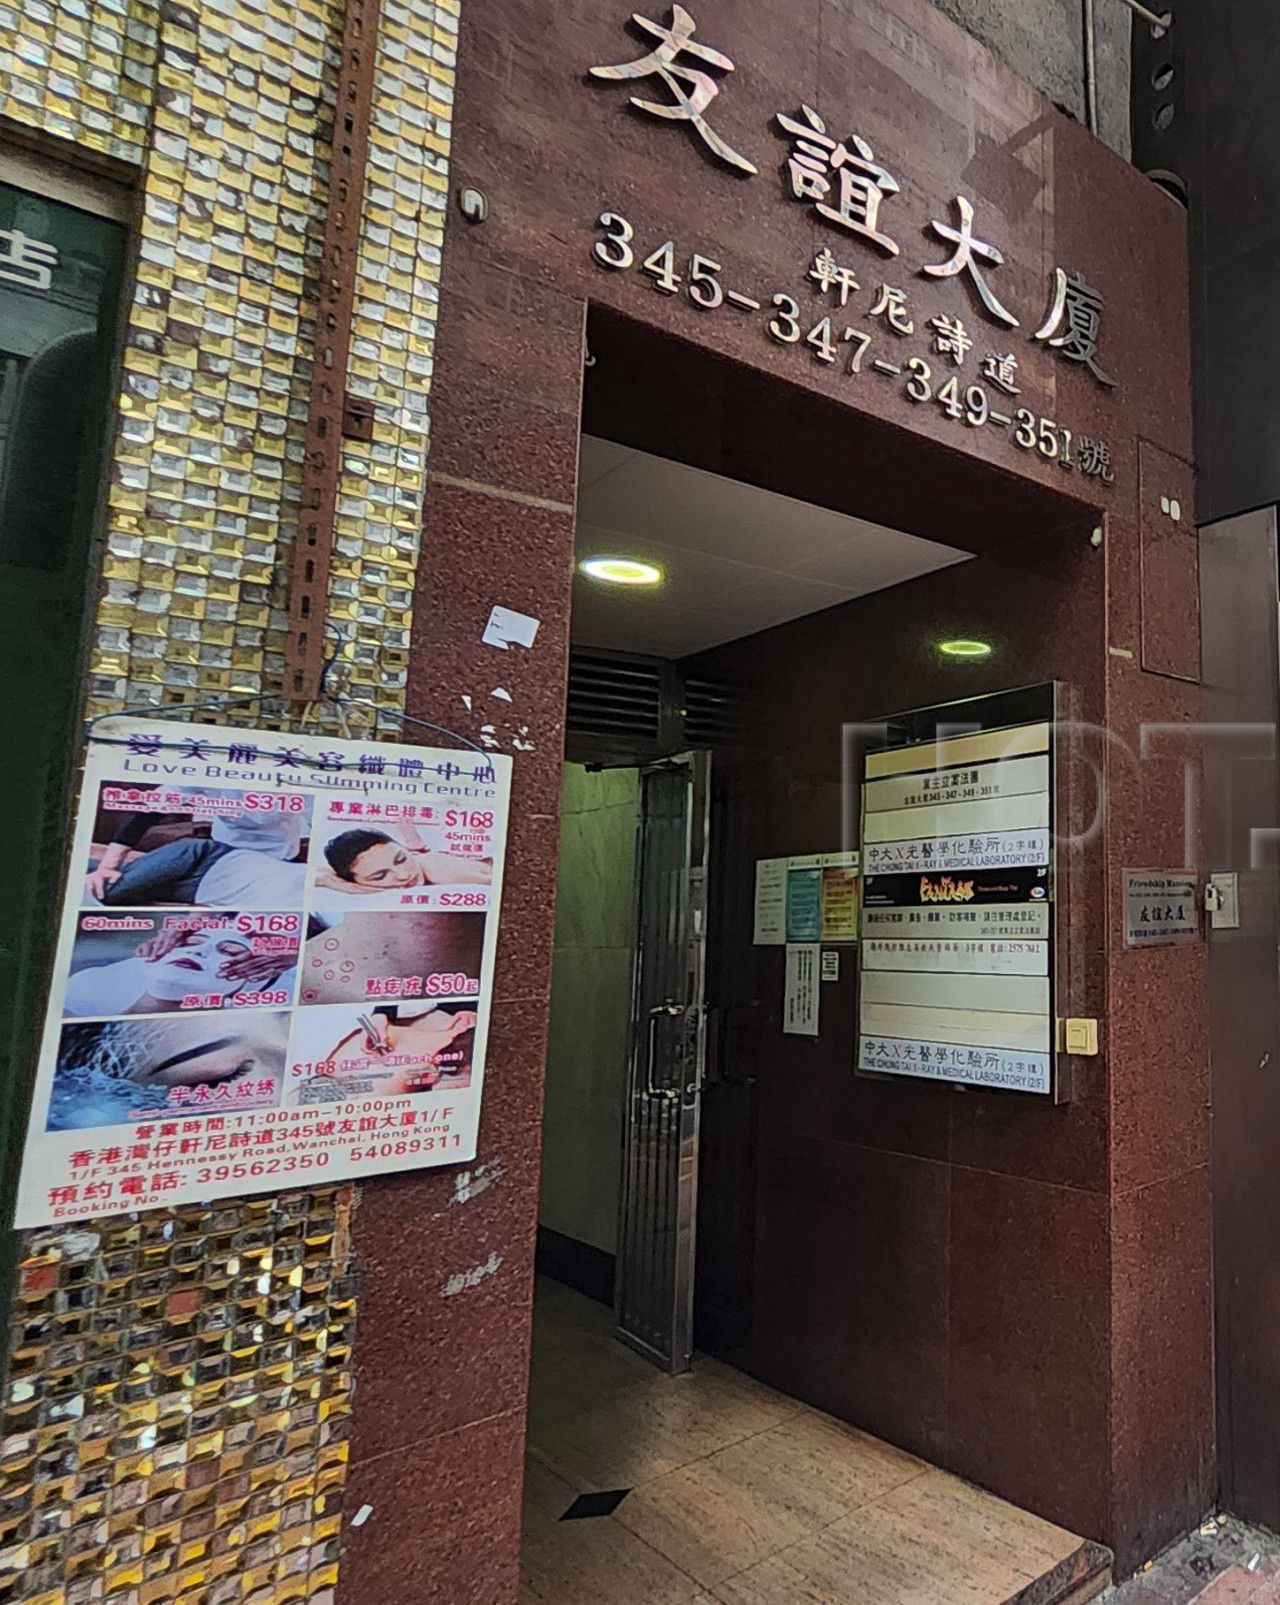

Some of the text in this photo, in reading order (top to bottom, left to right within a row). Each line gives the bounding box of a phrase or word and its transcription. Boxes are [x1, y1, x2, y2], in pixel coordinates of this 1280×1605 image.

[809, 247, 1022, 396] 軒尼詩道
[124, 758, 497, 798] Love Beauty Slimming Centre
[444, 831, 491, 842] 45mins
[943, 856, 975, 868] MEDICAL
[976, 853, 1026, 866] LABORATORY
[82, 917, 153, 930] 60mins
[942, 1066, 974, 1080] MEDICAL
[975, 1070, 1027, 1086] LABORATORY
[70, 1167, 102, 1180] 1/F
[107, 1163, 142, 1175] 345
[147, 1152, 238, 1170] Hennessy
[371, 1128, 409, 1141] Hong
[413, 1123, 450, 1135] Kong
[197, 1152, 329, 1184] 39562350
[350, 1134, 461, 1162] 54089311
[53, 1199, 129, 1218] Booking
